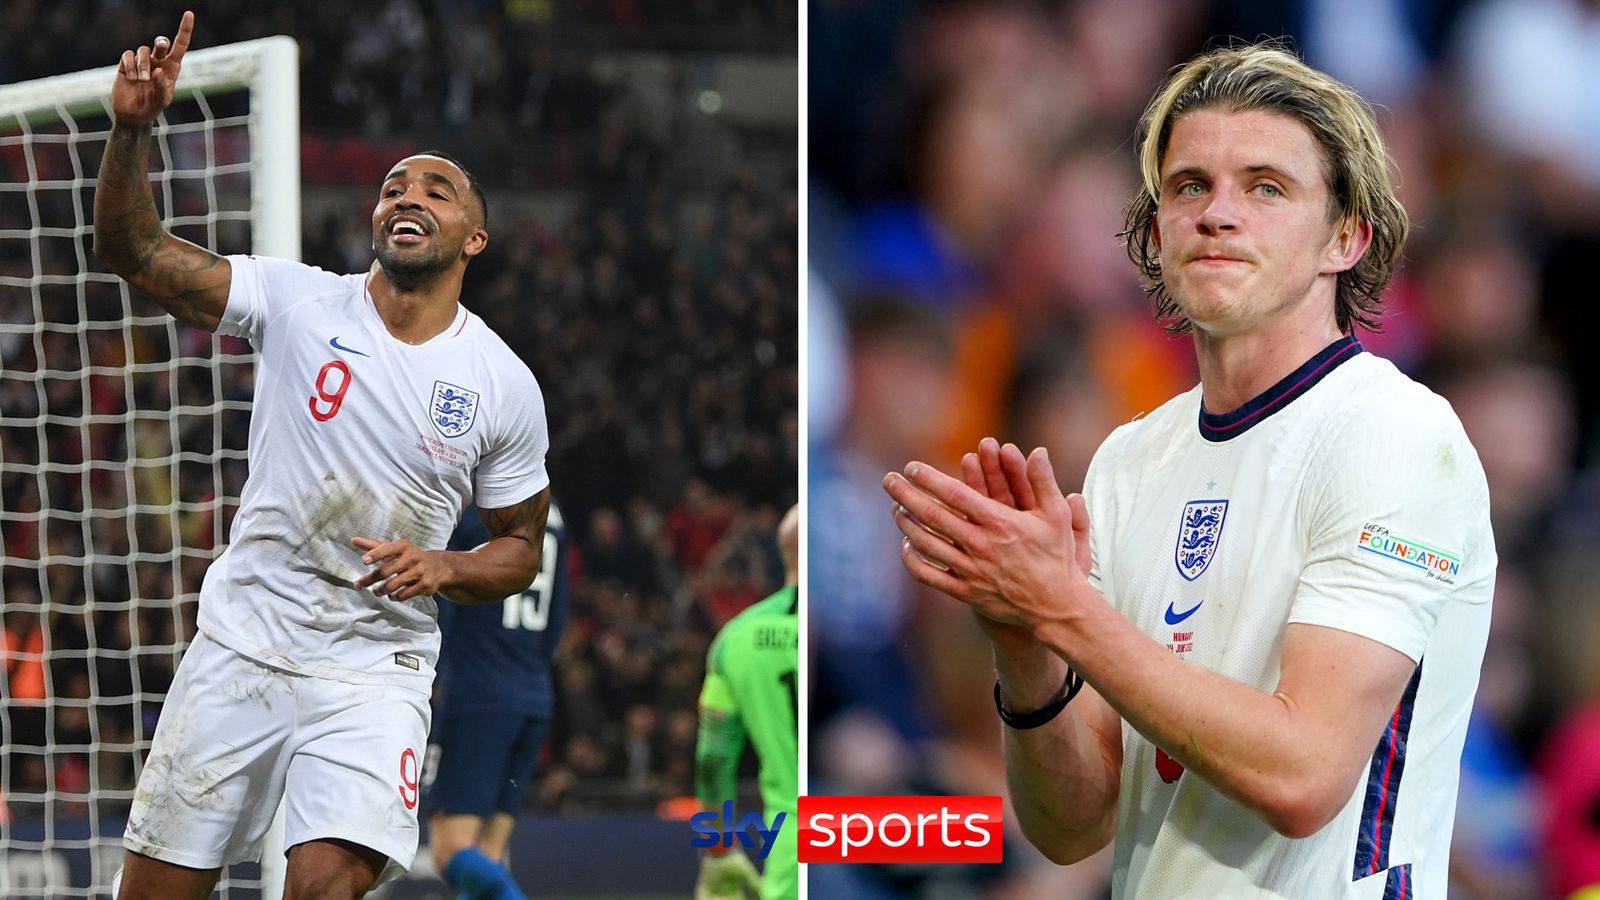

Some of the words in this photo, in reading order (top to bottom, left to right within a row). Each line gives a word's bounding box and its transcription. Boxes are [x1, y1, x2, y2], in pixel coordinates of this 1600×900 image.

[309, 360, 352, 422] 9
[1363, 522, 1389, 536] UEFA
[399, 747, 417, 809] 9
